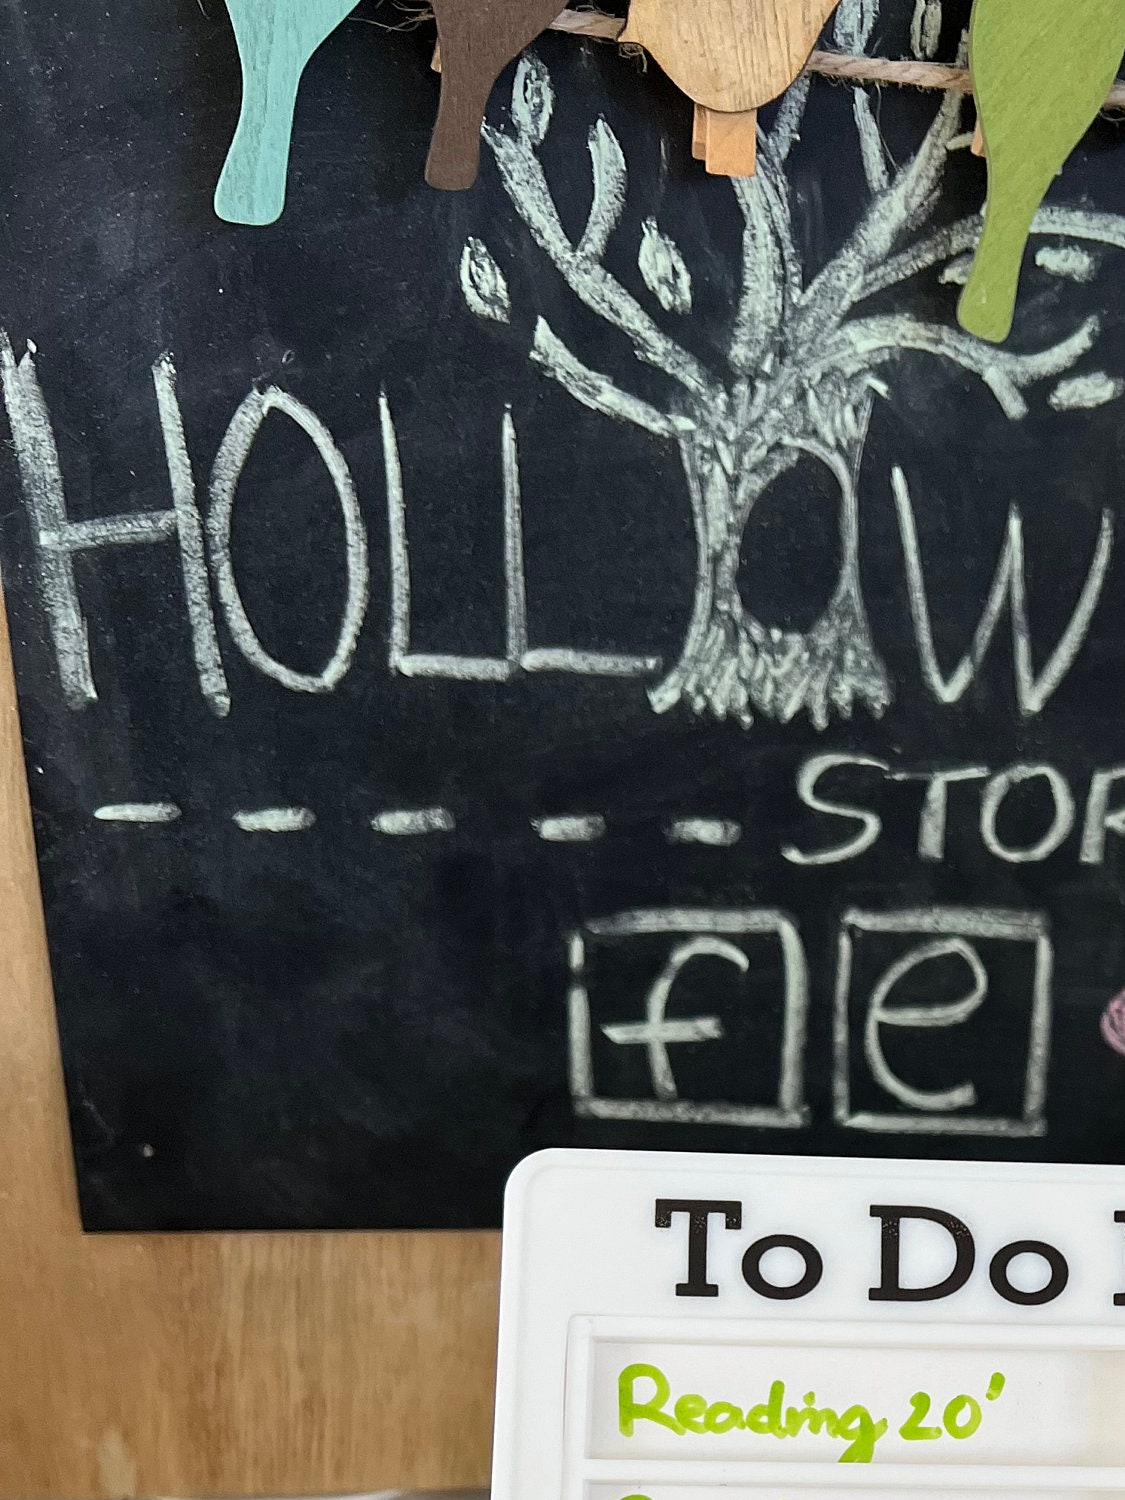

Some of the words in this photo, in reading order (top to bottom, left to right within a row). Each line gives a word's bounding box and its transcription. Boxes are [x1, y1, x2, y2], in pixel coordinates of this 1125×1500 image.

[603, 936, 749, 1091] f
[866, 938, 988, 1109] e
[655, 1199, 823, 1300] To
[869, 1205, 1069, 1305] Do
[618, 1364, 888, 1463] Reading
